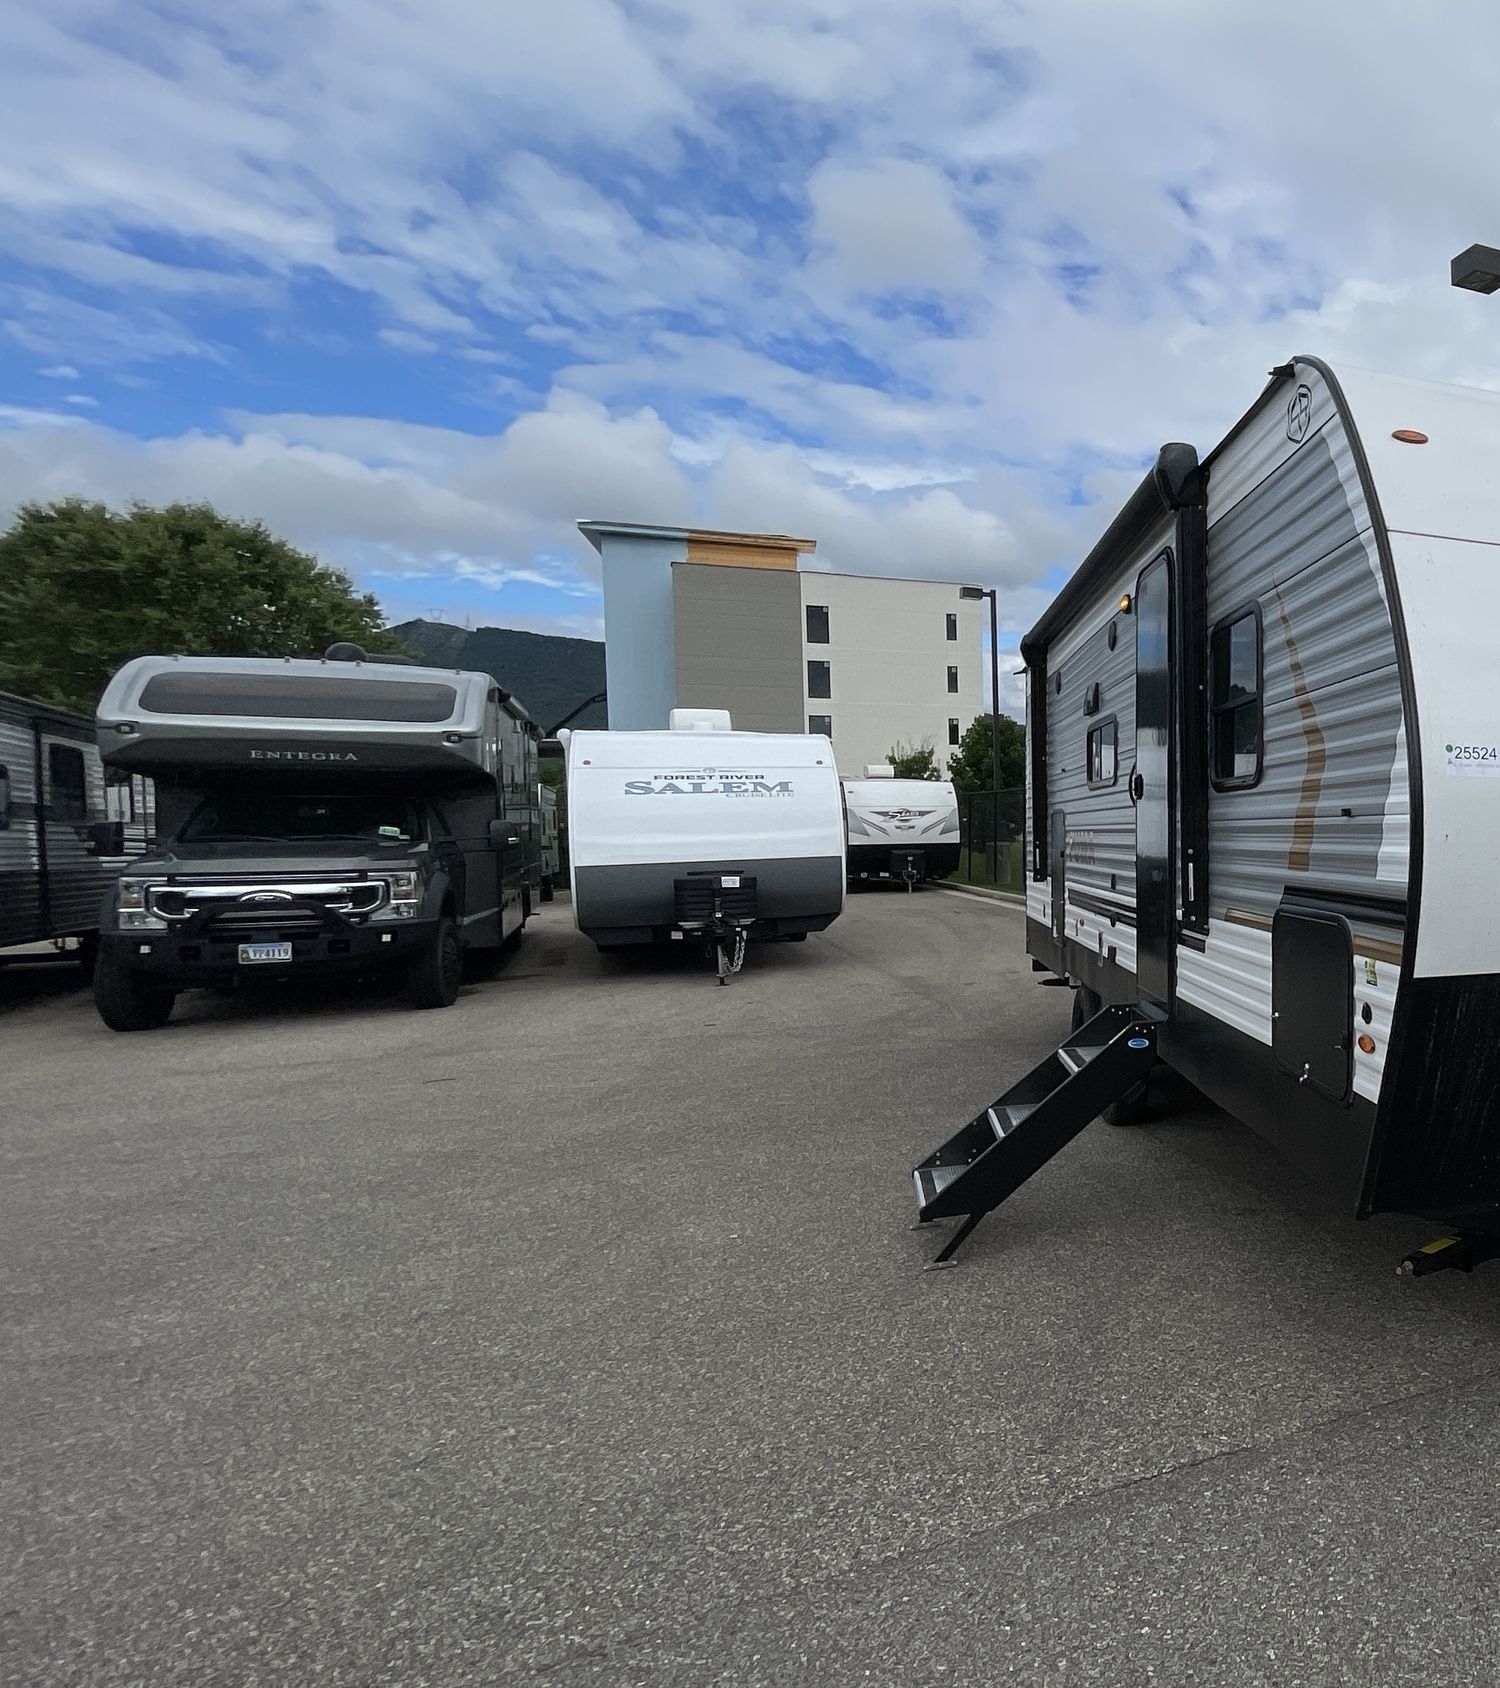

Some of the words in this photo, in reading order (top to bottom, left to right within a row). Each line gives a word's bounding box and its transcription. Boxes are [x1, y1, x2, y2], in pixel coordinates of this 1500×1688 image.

[248, 749, 359, 761] ENTEGRA
[1454, 745, 1498, 761] 25524
[624, 780, 794, 796] SALEM
